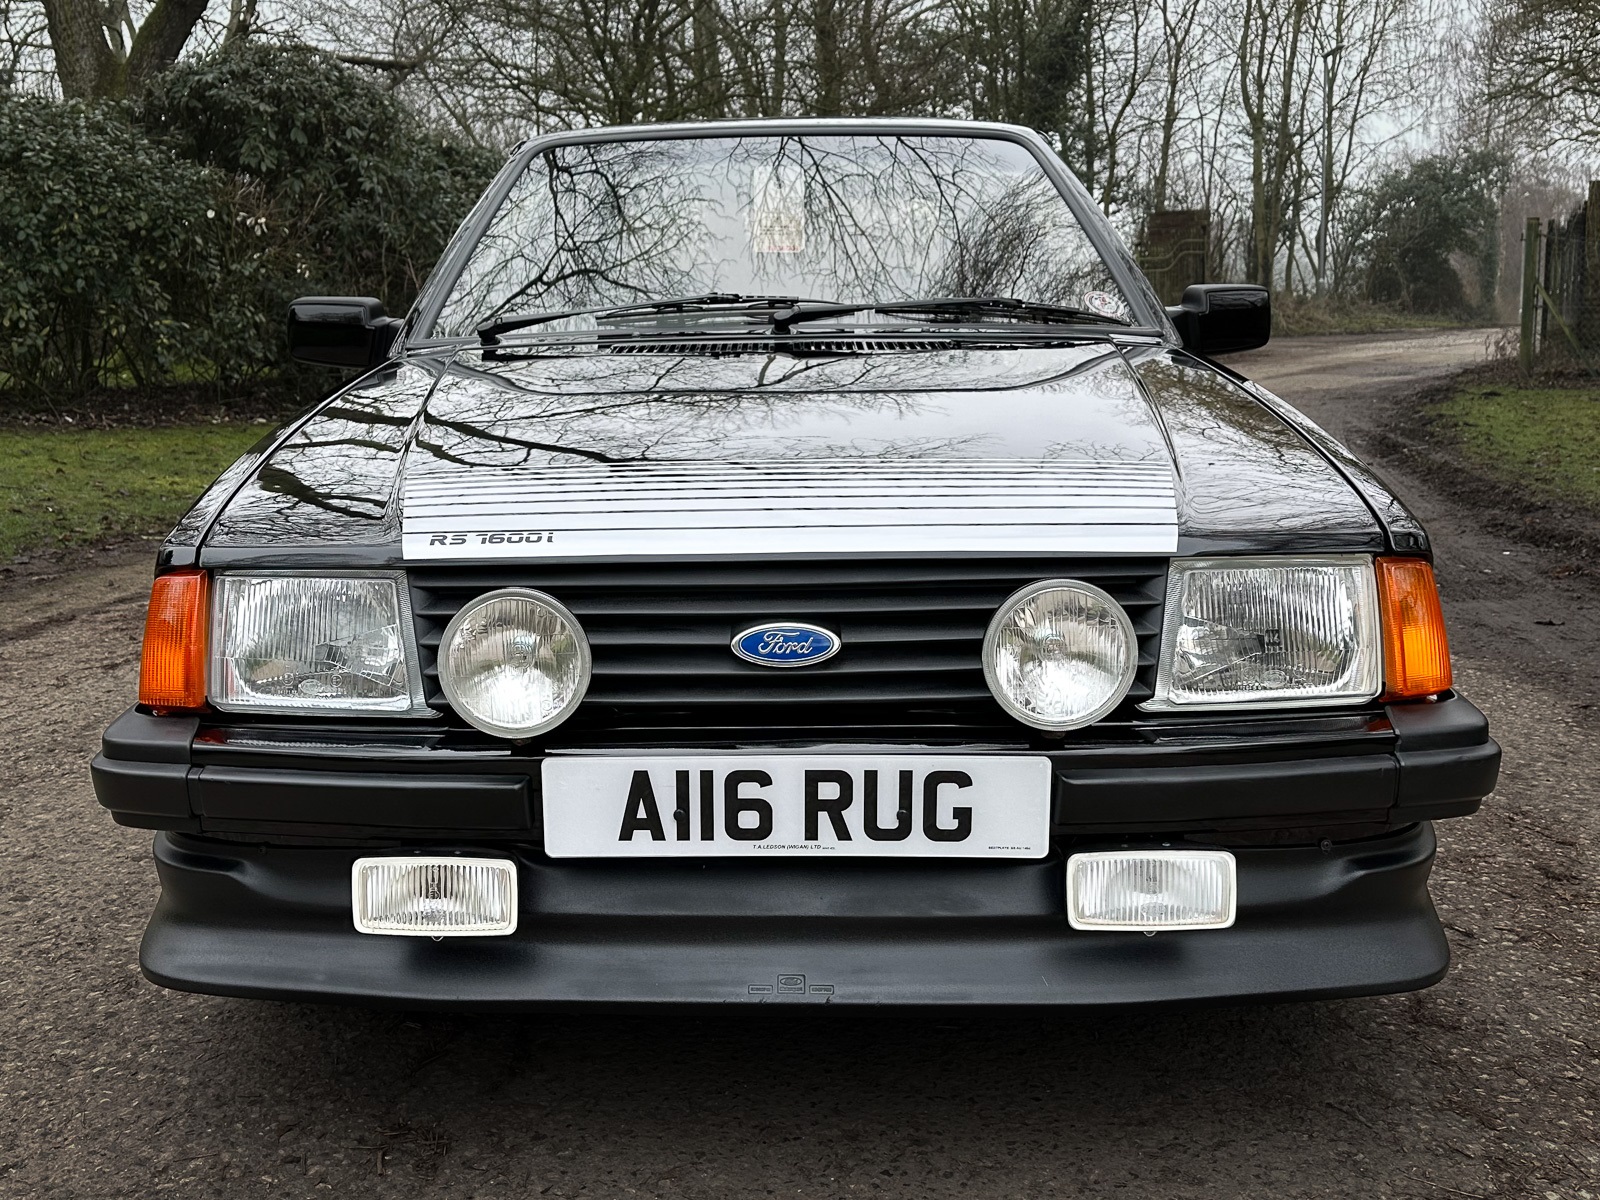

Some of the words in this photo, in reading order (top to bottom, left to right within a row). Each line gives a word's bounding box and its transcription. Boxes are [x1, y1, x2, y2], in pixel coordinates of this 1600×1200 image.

[429, 534, 468, 546] RS
[757, 631, 814, 655] Ford
[618, 769, 773, 842] A116
[804, 769, 973, 843] RUG
